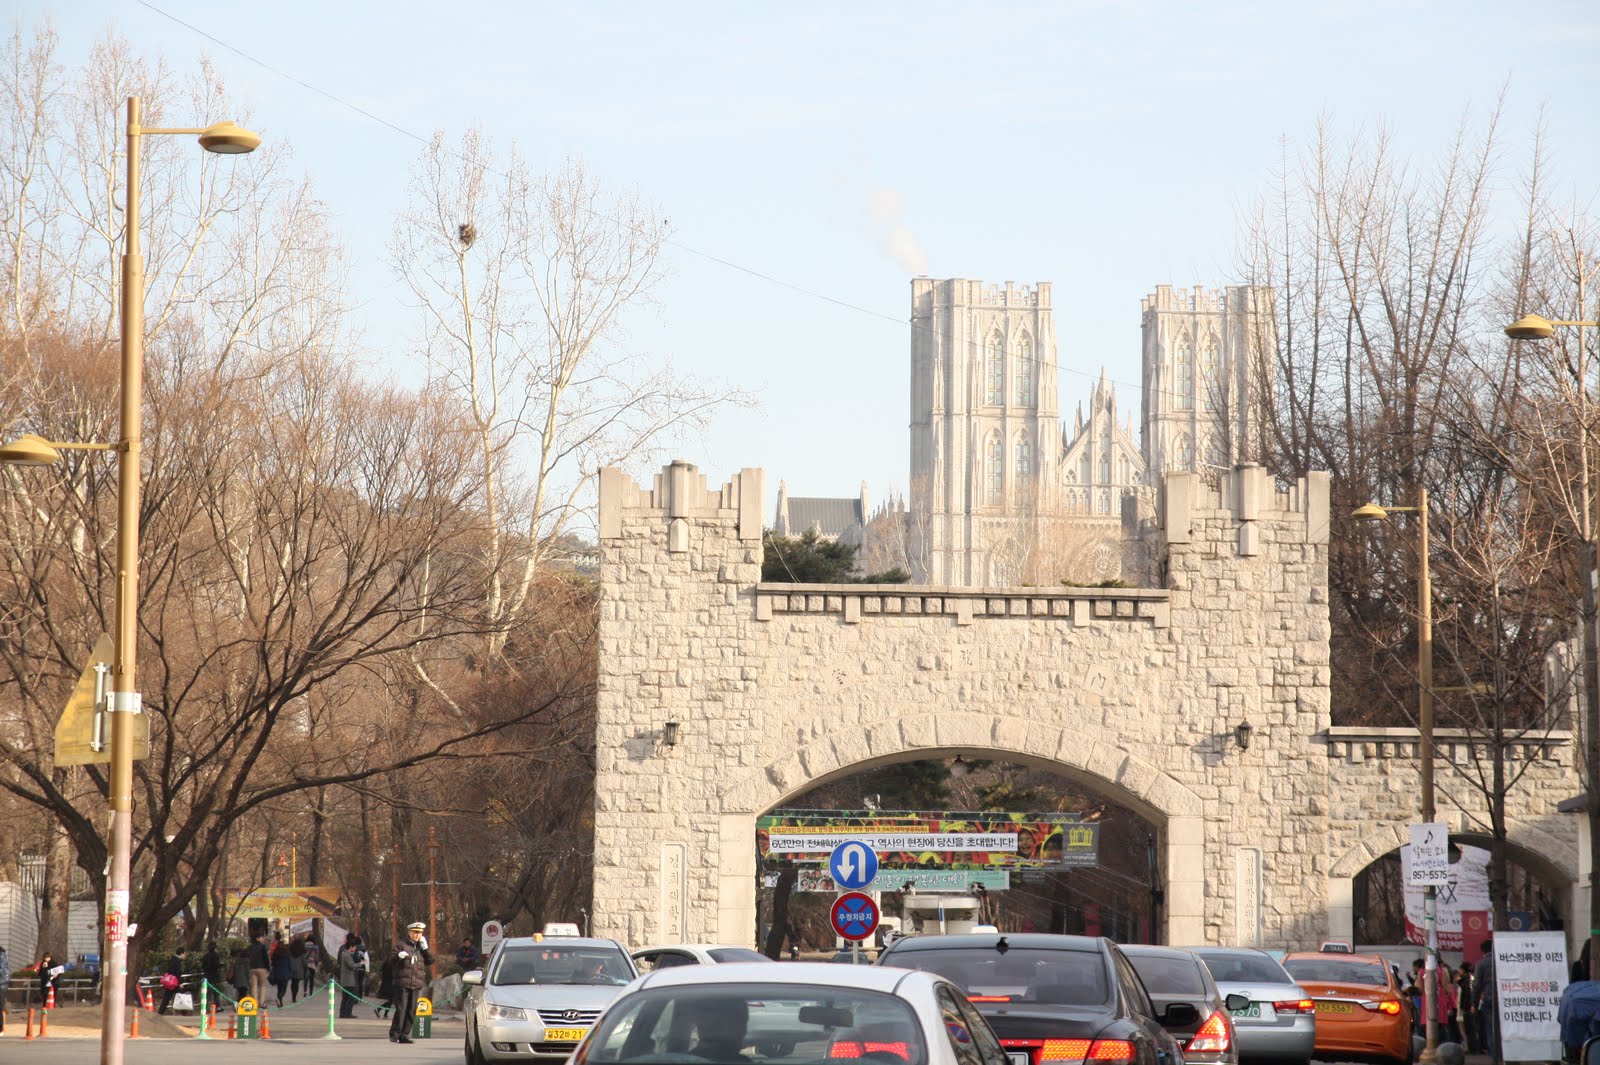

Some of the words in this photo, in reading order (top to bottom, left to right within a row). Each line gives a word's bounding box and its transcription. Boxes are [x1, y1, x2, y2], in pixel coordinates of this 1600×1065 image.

[771, 838, 805, 849] 6년만의
[866, 839, 876, 848] 그
[877, 838, 905, 848] 역사의
[907, 838, 935, 848] 현장에
[937, 838, 964, 848] 당신을
[966, 838, 1014, 848] 초대합니다!
[1412, 870, 1448, 880] 957-5575
[839, 913, 872, 922] 주정차금지
[1499, 952, 1542, 963] 버스정류장
[1545, 952, 1563, 963] 이전
[1501, 981, 1559, 993] 버스정류장을
[1503, 996, 1545, 1008] 경희의료원
[1504, 1010, 1552, 1022] 이전합니다
